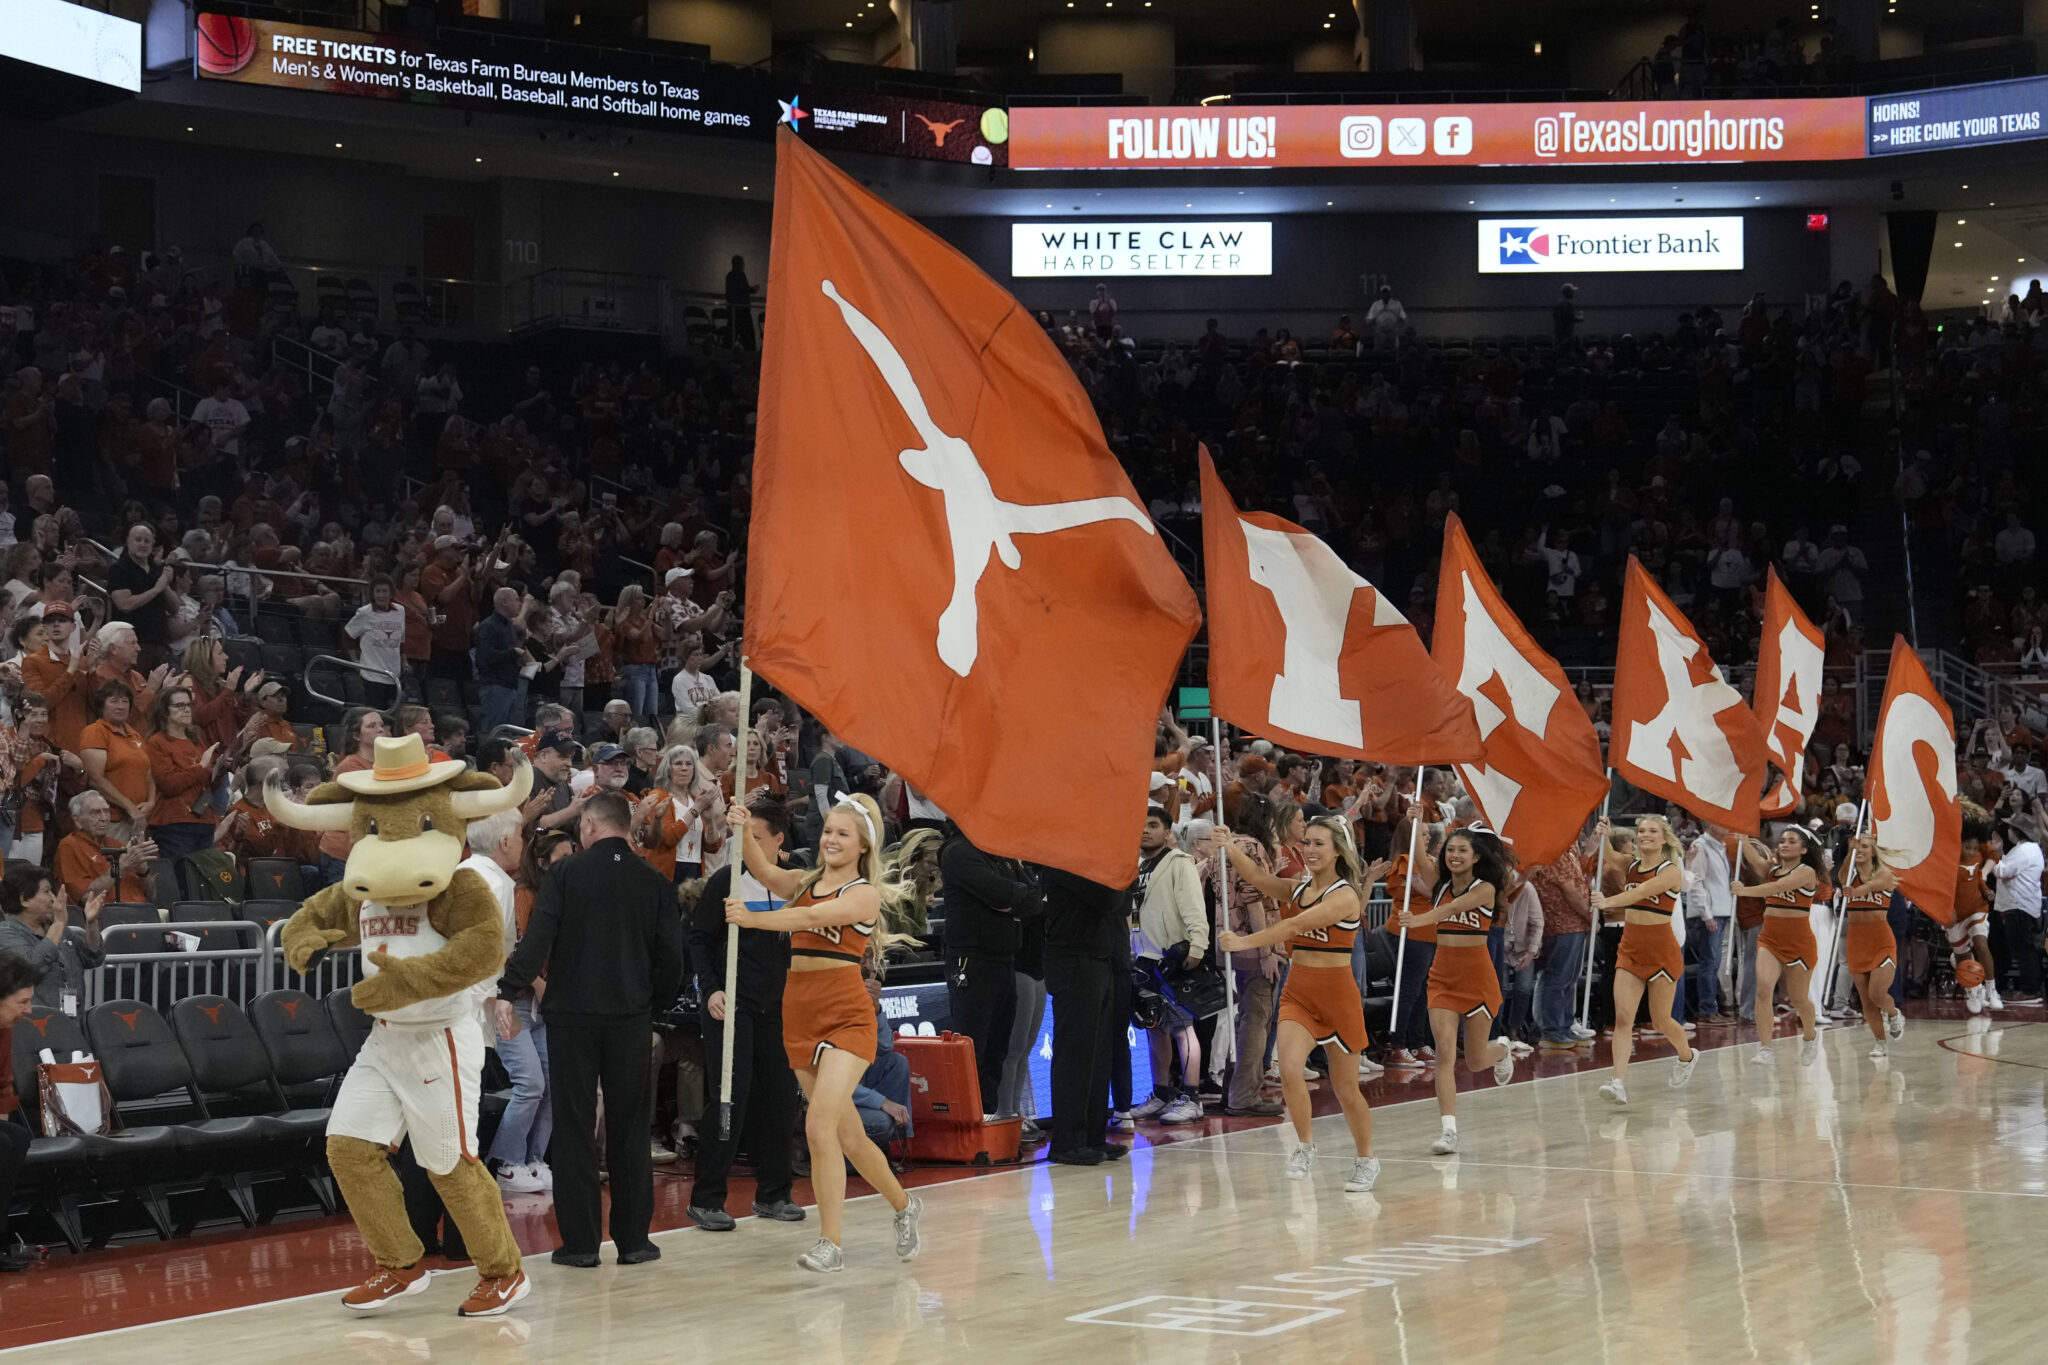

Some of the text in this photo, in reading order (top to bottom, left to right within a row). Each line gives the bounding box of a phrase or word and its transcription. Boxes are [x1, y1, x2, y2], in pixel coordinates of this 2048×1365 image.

[272, 34, 700, 101] FREE TICKETS for Texas Farm Bureau Members to Texas
[272, 57, 751, 127] Men's & Women's Basketball, Baseball, and Softball home games
[813, 107, 887, 124] TEXAS FARM BUREAU
[1873, 100, 1920, 124] HORNS!
[1108, 116, 1276, 159] FOLLOW US!
[1534, 110, 1784, 157] @TexasLonghorns
[1890, 125, 1922, 146] HERE
[1923, 121, 1961, 142] COME
[1962, 118, 1998, 137] YOUR
[2000, 111, 2040, 133] TEXAS
[505, 239, 538, 264] 110
[1041, 231, 1243, 249] WHITE CLAW
[1556, 230, 1721, 255] Frontier Bank
[1043, 254, 1241, 271] HARD SELTZER
[1872, 691, 1956, 870] S
[360, 914, 418, 939] TEXAS
